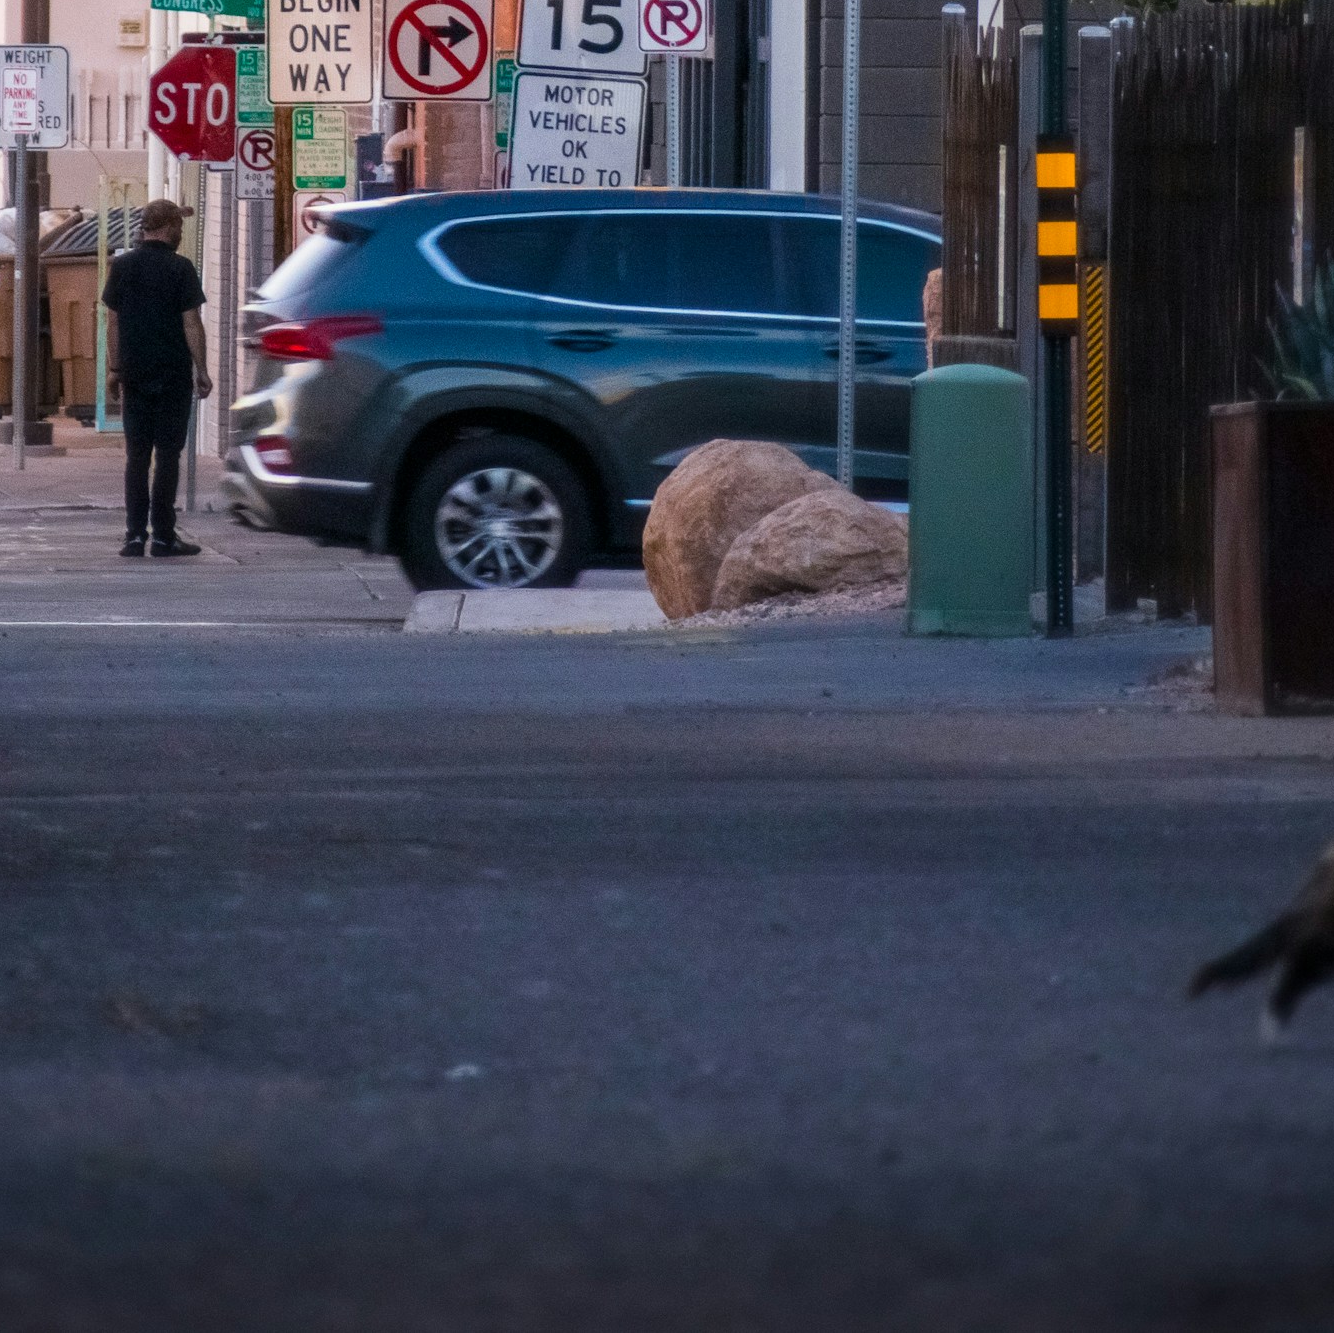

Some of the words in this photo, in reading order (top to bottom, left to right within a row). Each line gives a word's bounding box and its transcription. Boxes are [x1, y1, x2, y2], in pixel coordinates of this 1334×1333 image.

[289, 24, 352, 53] ONE
[4, 50, 52, 64] WEIGHT
[242, 52, 255, 65] 15
[13, 73, 27, 86] NO
[289, 63, 352, 92] WAY
[4, 87, 36, 100] PARKING
[155, 81, 229, 126] STO
[544, 84, 614, 107] MOTOR
[296, 113, 312, 126] 15
[529, 110, 627, 135] VEHICLES
[561, 139, 588, 159] OK
[526, 163, 586, 185] YIELD
[596, 168, 622, 187] TO
